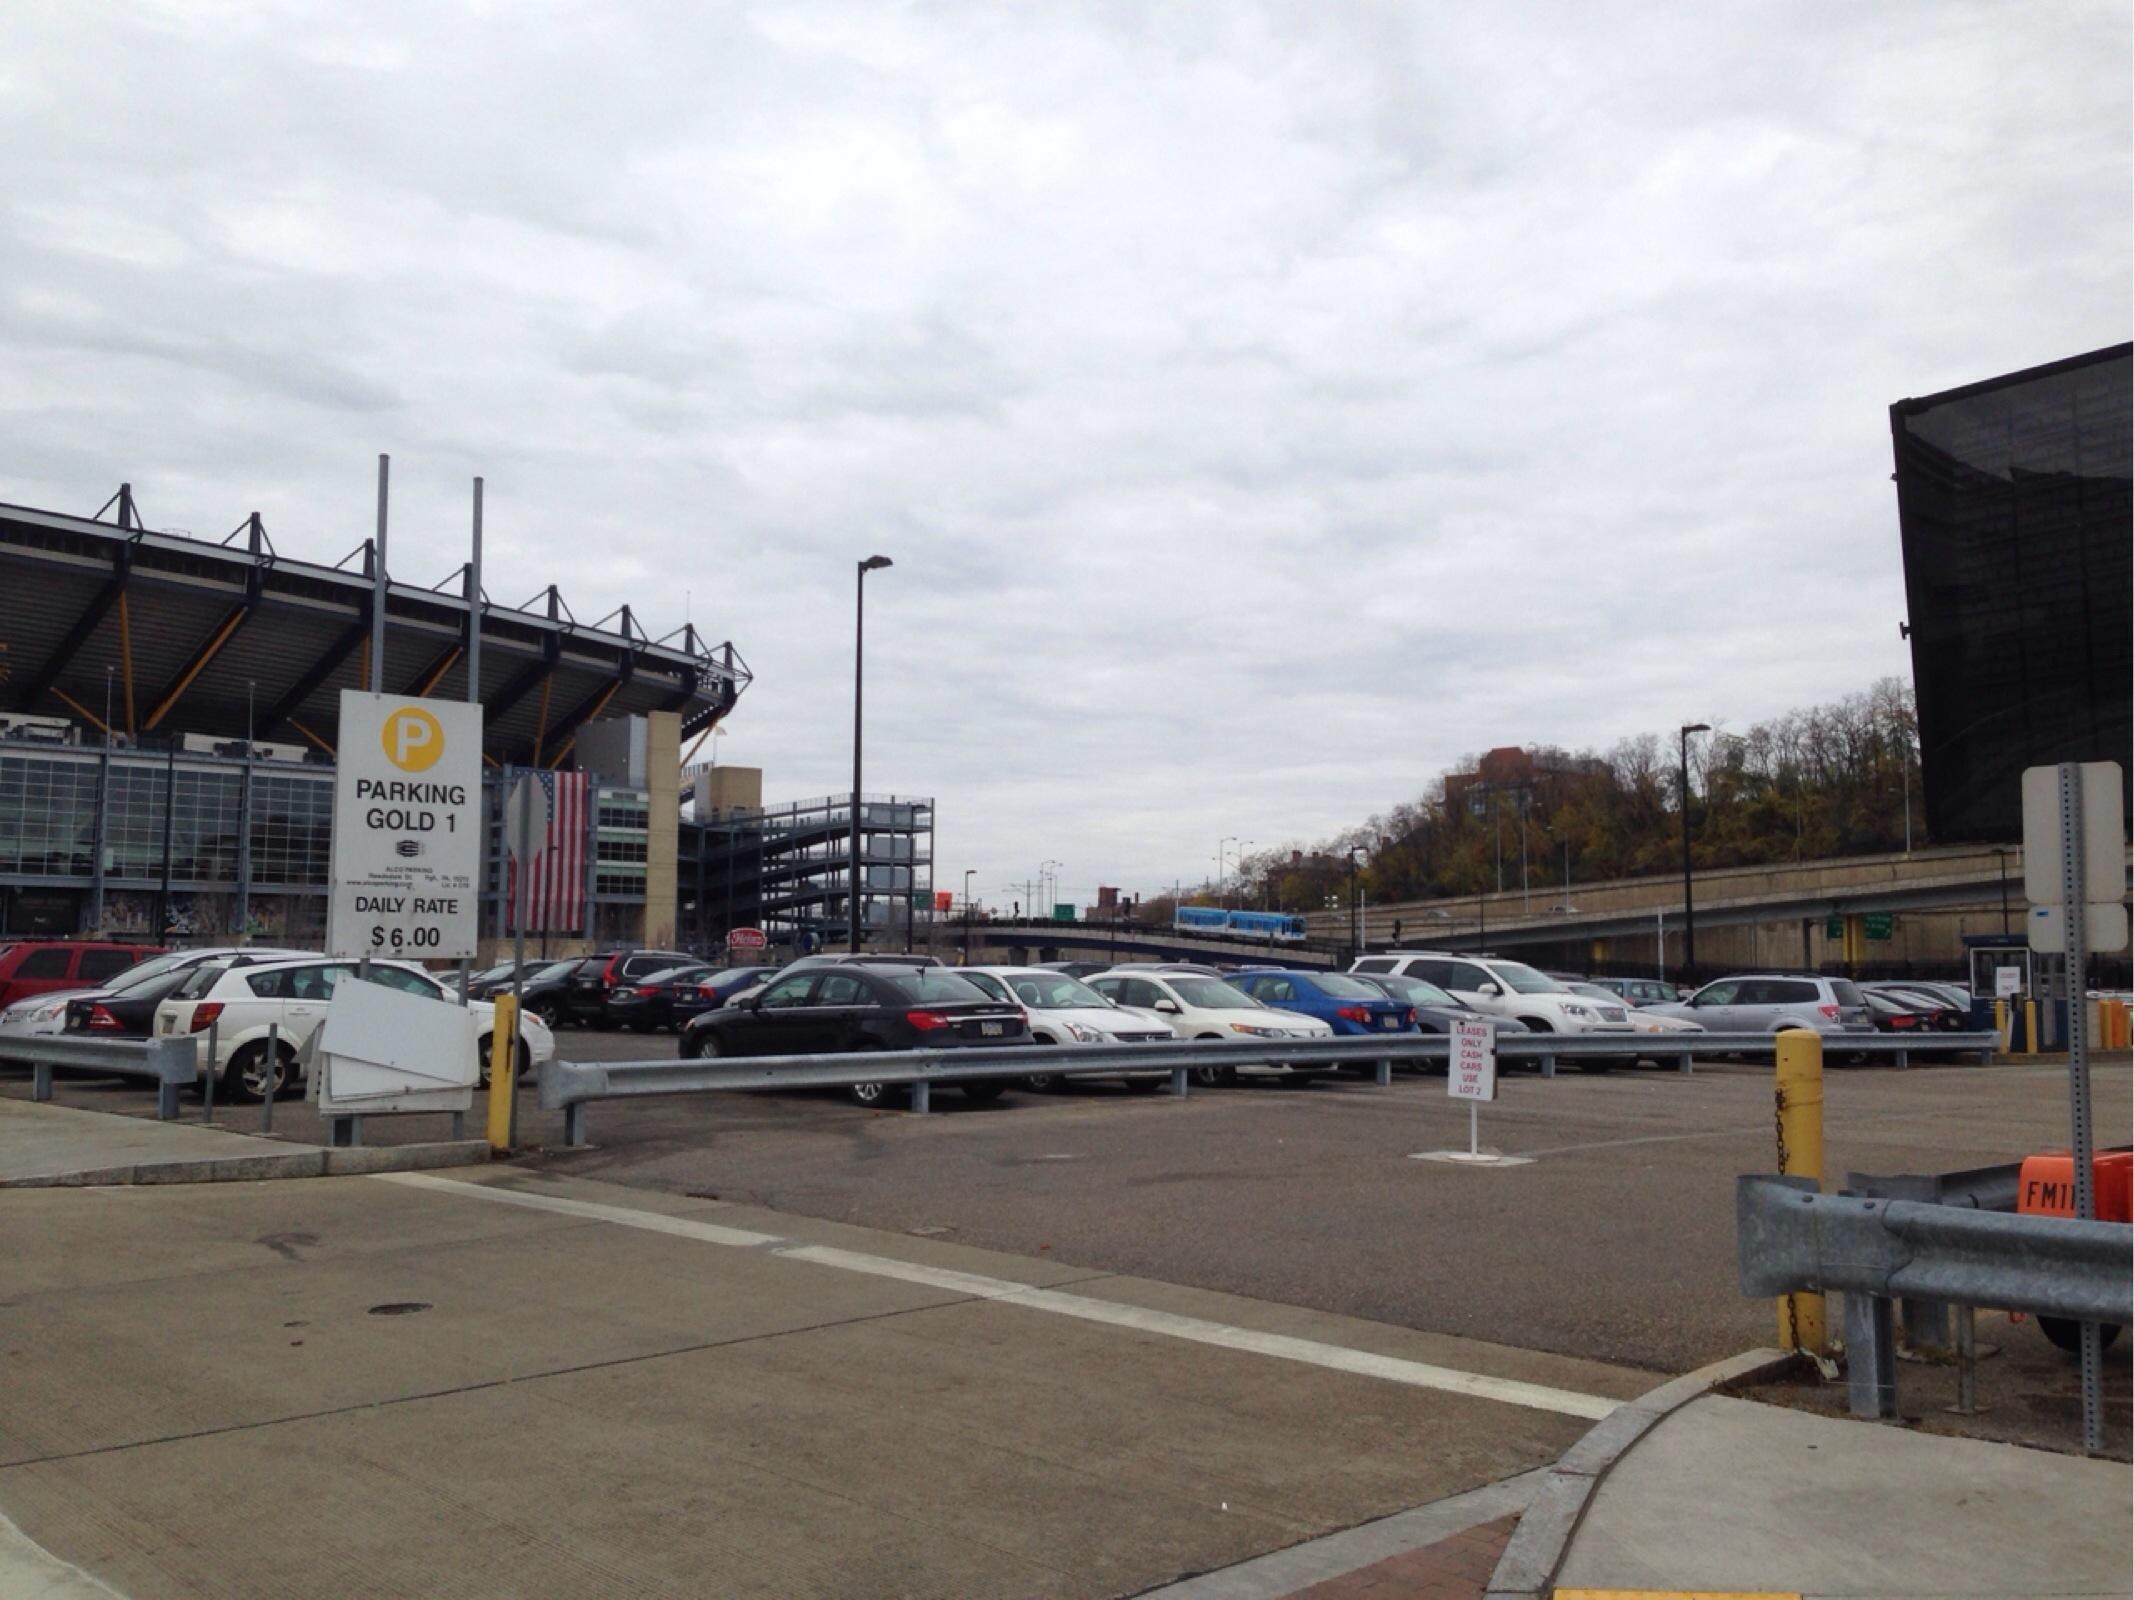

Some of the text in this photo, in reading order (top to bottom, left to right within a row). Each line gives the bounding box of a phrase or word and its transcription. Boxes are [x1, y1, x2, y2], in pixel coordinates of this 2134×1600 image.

[396, 716, 432, 763] P
[356, 779, 465, 806] PARKING
[366, 808, 456, 833] GOLD 1
[355, 896, 458, 914] DAILY RATE
[371, 925, 440, 947] $6.00
[1456, 1025, 1487, 1037] LEASES
[1461, 1038, 1481, 1048] ONLY
[1461, 1049, 1482, 1059] CASH
[1460, 1061, 1482, 1072] CARS
[1462, 1073, 1478, 1083] USE
[1458, 1084, 1474, 1094] LOT
